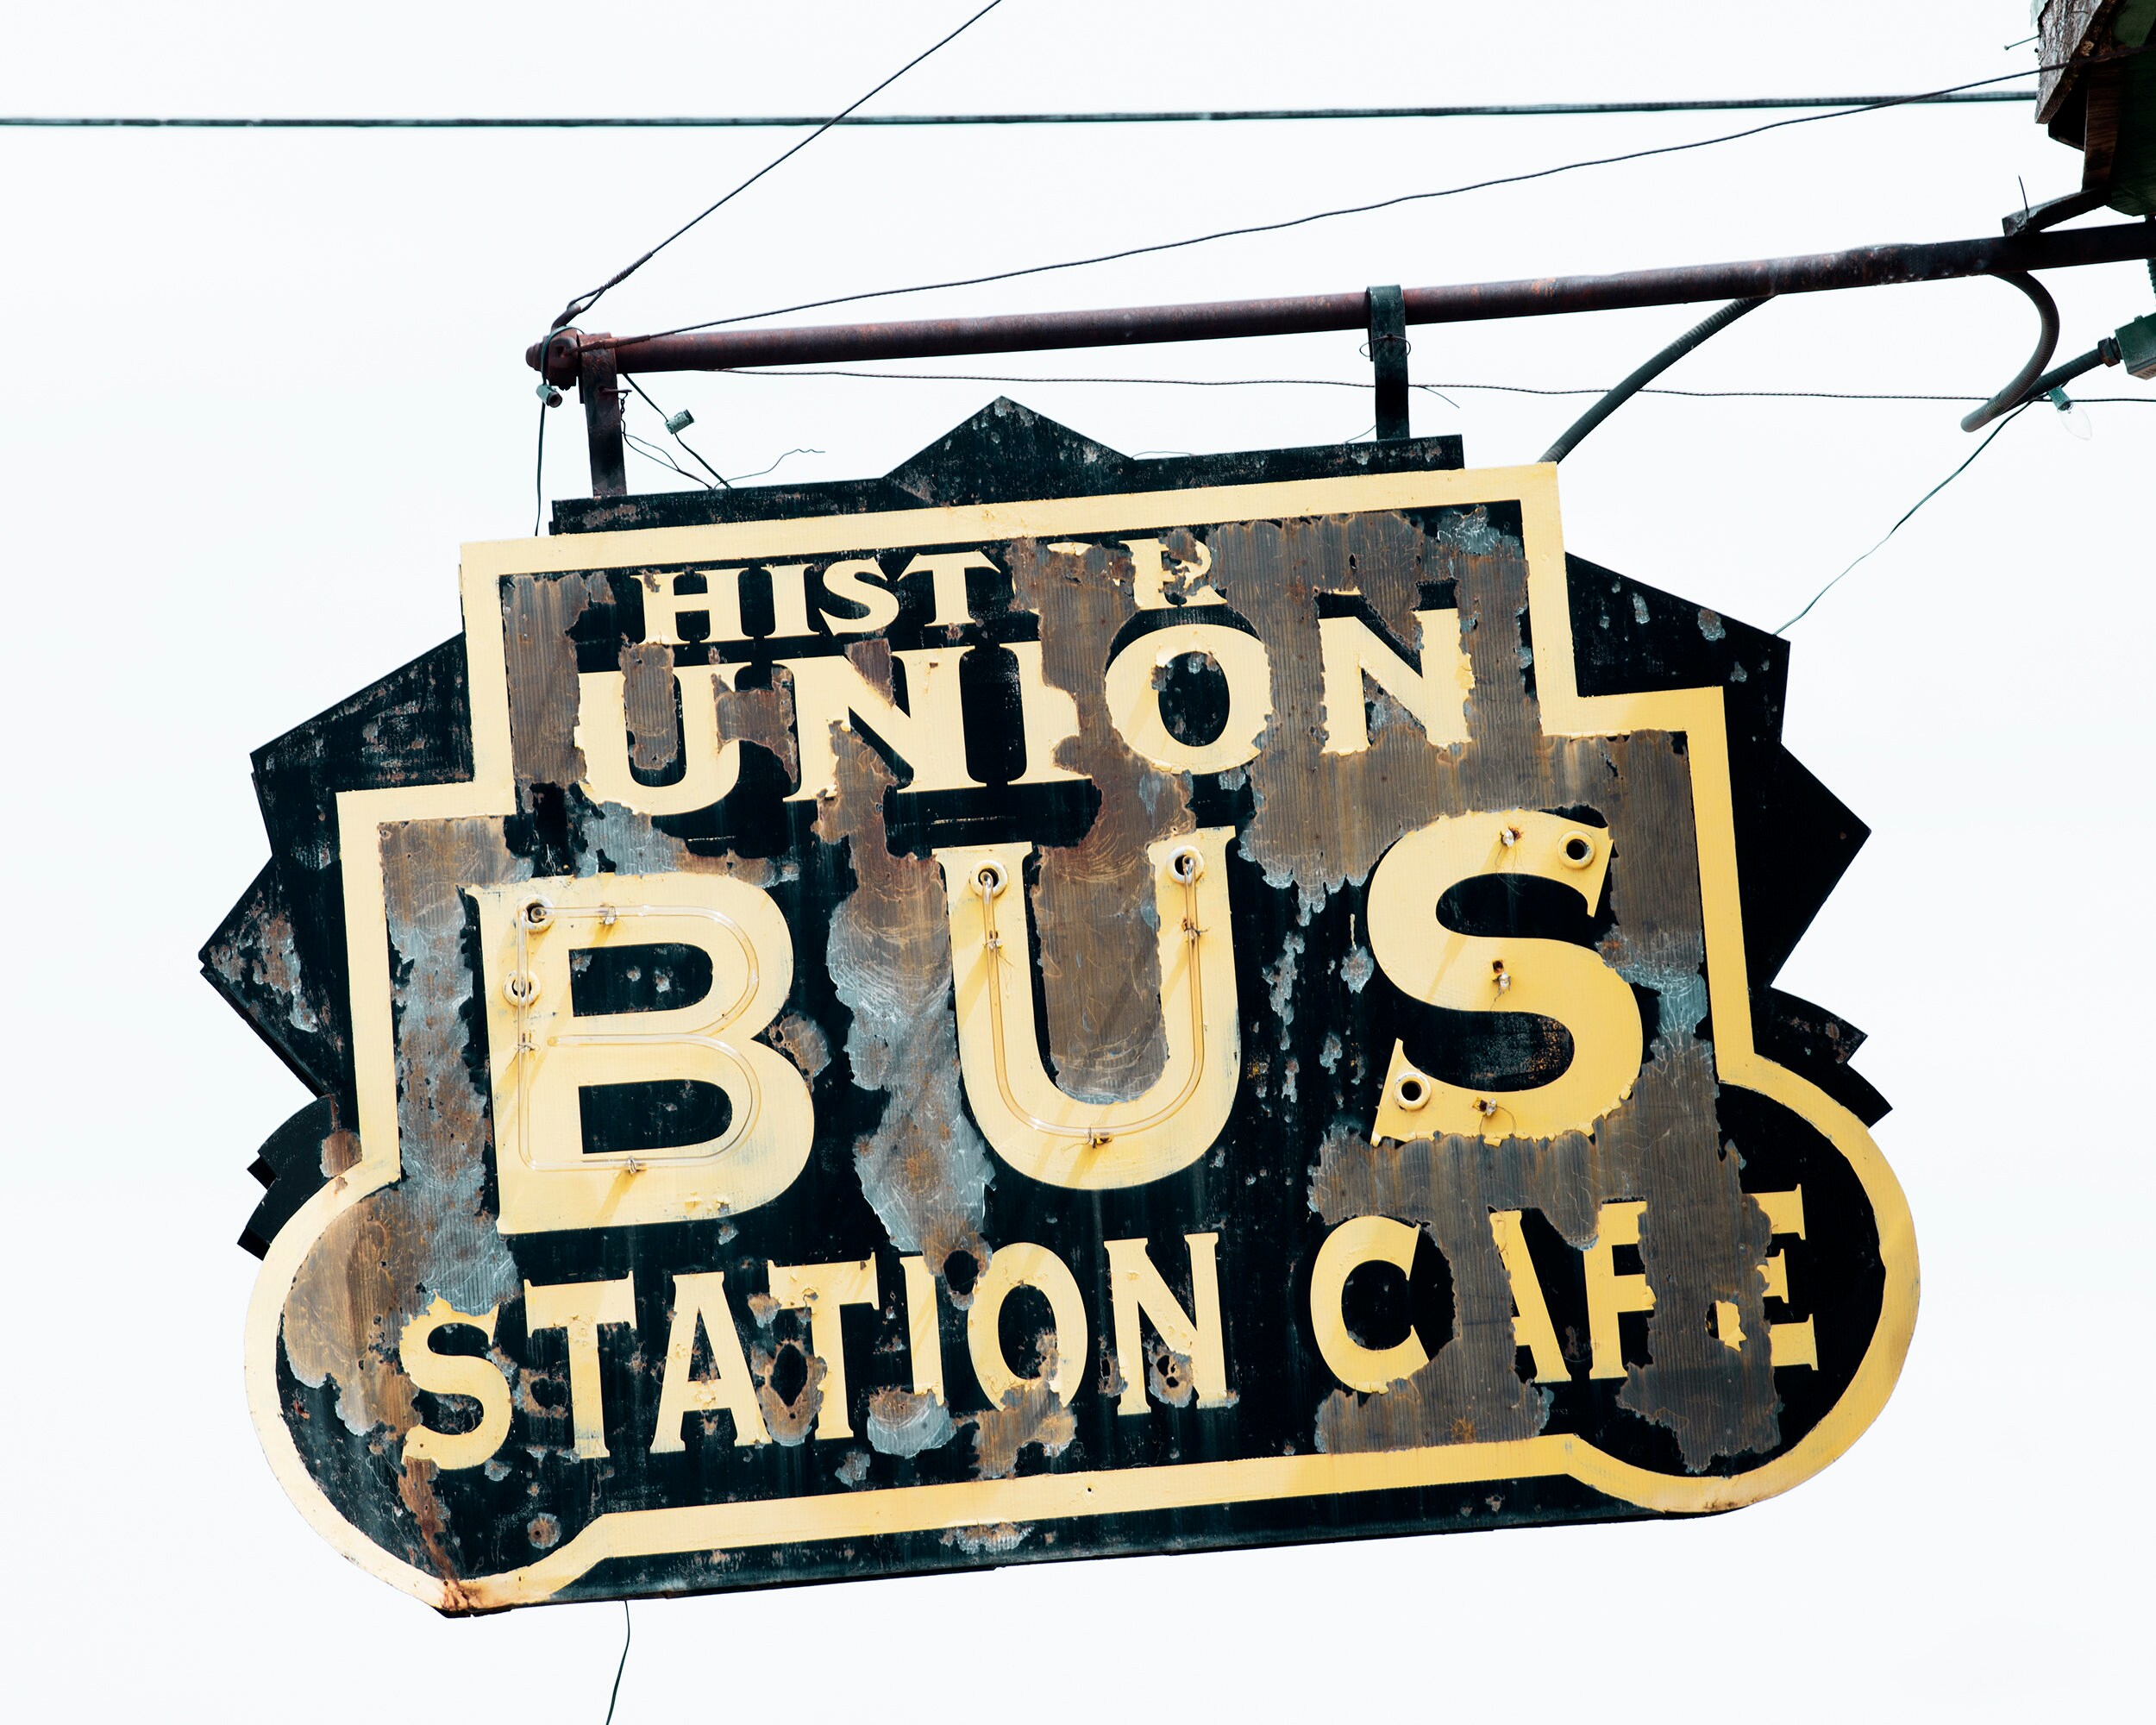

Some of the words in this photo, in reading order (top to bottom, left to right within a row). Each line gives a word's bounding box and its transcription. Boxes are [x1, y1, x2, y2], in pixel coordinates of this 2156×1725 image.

[630, 537, 1228, 645] HISTR
[574, 608, 1476, 817] UNION
[465, 809, 1644, 1234] BUS
[400, 1233, 1228, 1470] STATION
